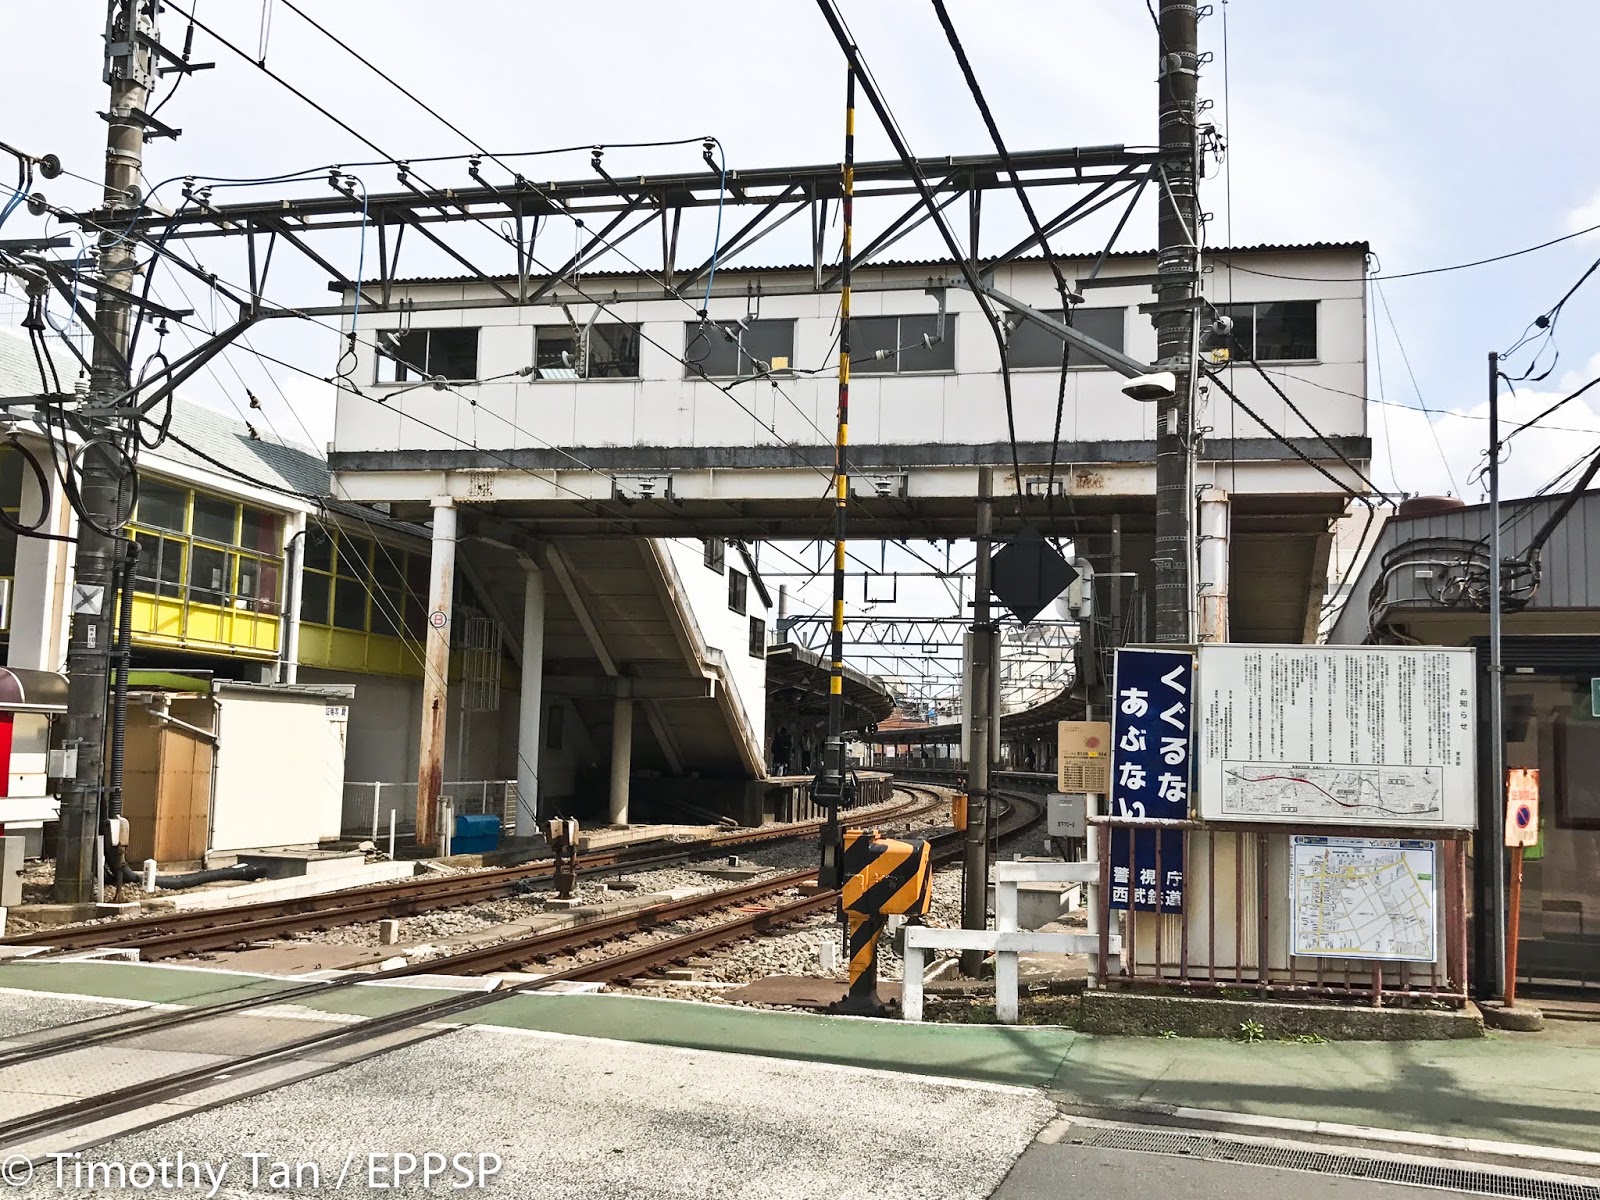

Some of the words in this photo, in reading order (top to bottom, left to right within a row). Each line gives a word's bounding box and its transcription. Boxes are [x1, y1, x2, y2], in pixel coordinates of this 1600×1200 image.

[1459, 688, 1468, 731] お知らせ
[1118, 687, 1149, 818] あぶない
[1158, 664, 1188, 803] くぐるな
[1112, 885, 1183, 907] 西武鉄道
[1113, 865, 1183, 888] 警視庁
